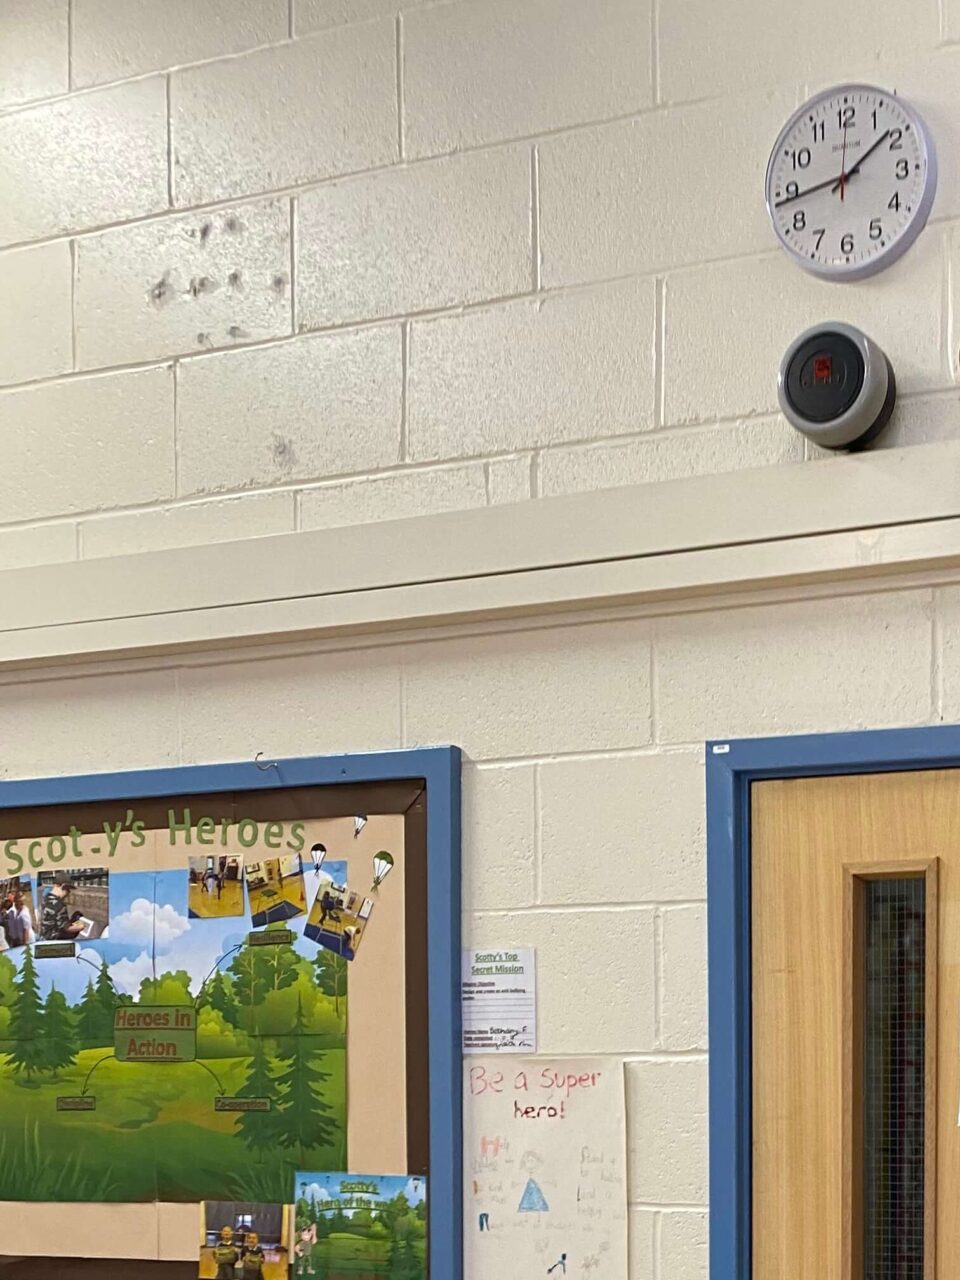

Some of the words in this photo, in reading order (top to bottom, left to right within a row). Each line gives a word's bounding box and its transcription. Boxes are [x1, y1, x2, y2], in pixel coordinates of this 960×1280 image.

[838, 106, 856, 129] 12
[871, 109, 877, 130] 1
[811, 120, 825, 143] 11
[889, 127, 903, 150] 2
[791, 147, 811, 170] 10
[895, 158, 909, 180] 3
[785, 180, 799, 201] 9
[888, 191, 900, 212] 4
[792, 210, 806, 231] 8
[869, 217, 882, 240] 5
[812, 228, 825, 251] 7
[840, 234, 854, 255] 6
[4, 809, 146, 876] Scoty's
[167, 807, 306, 851] Heroes
[475, 952, 503, 963] Scotty's
[504, 952, 518, 962] Top
[471, 965, 493, 976] Secret
[494, 964, 524, 975] Mission
[116, 1009, 170, 1026] Heroes
[174, 1008, 191, 1026] in
[127, 1038, 177, 1056] Action
[470, 1065, 504, 1095] Be
[514, 1071, 528, 1091] a
[540, 1068, 602, 1098] Super
[513, 1100, 565, 1119] hero!
